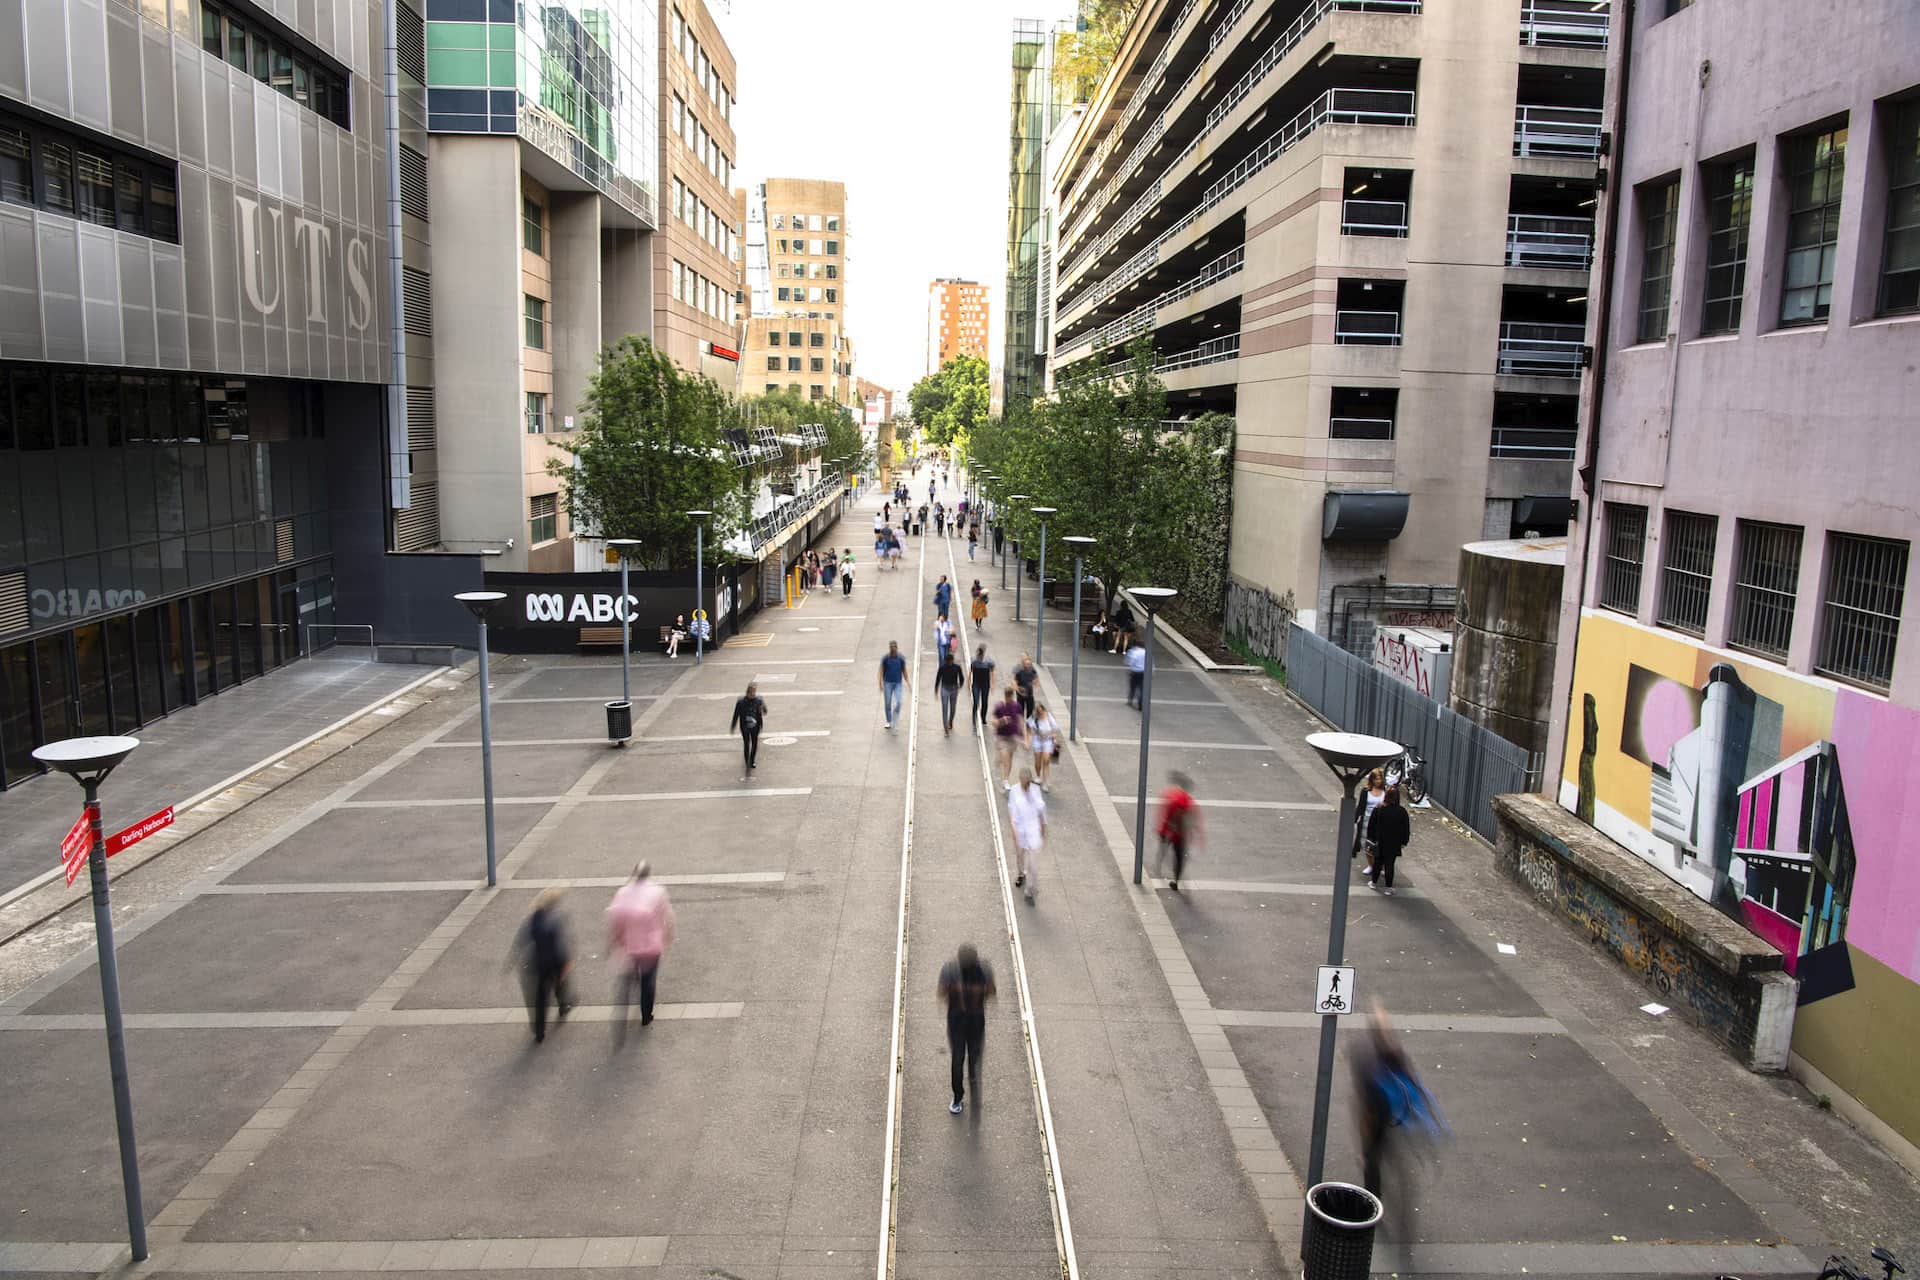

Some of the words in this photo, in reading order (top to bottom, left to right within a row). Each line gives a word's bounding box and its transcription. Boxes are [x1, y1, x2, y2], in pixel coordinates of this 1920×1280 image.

[235, 195, 371, 331] UTS
[567, 594, 640, 622] ABC
[121, 828, 143, 845] Darling
[143, 816, 165, 833] Harbour
